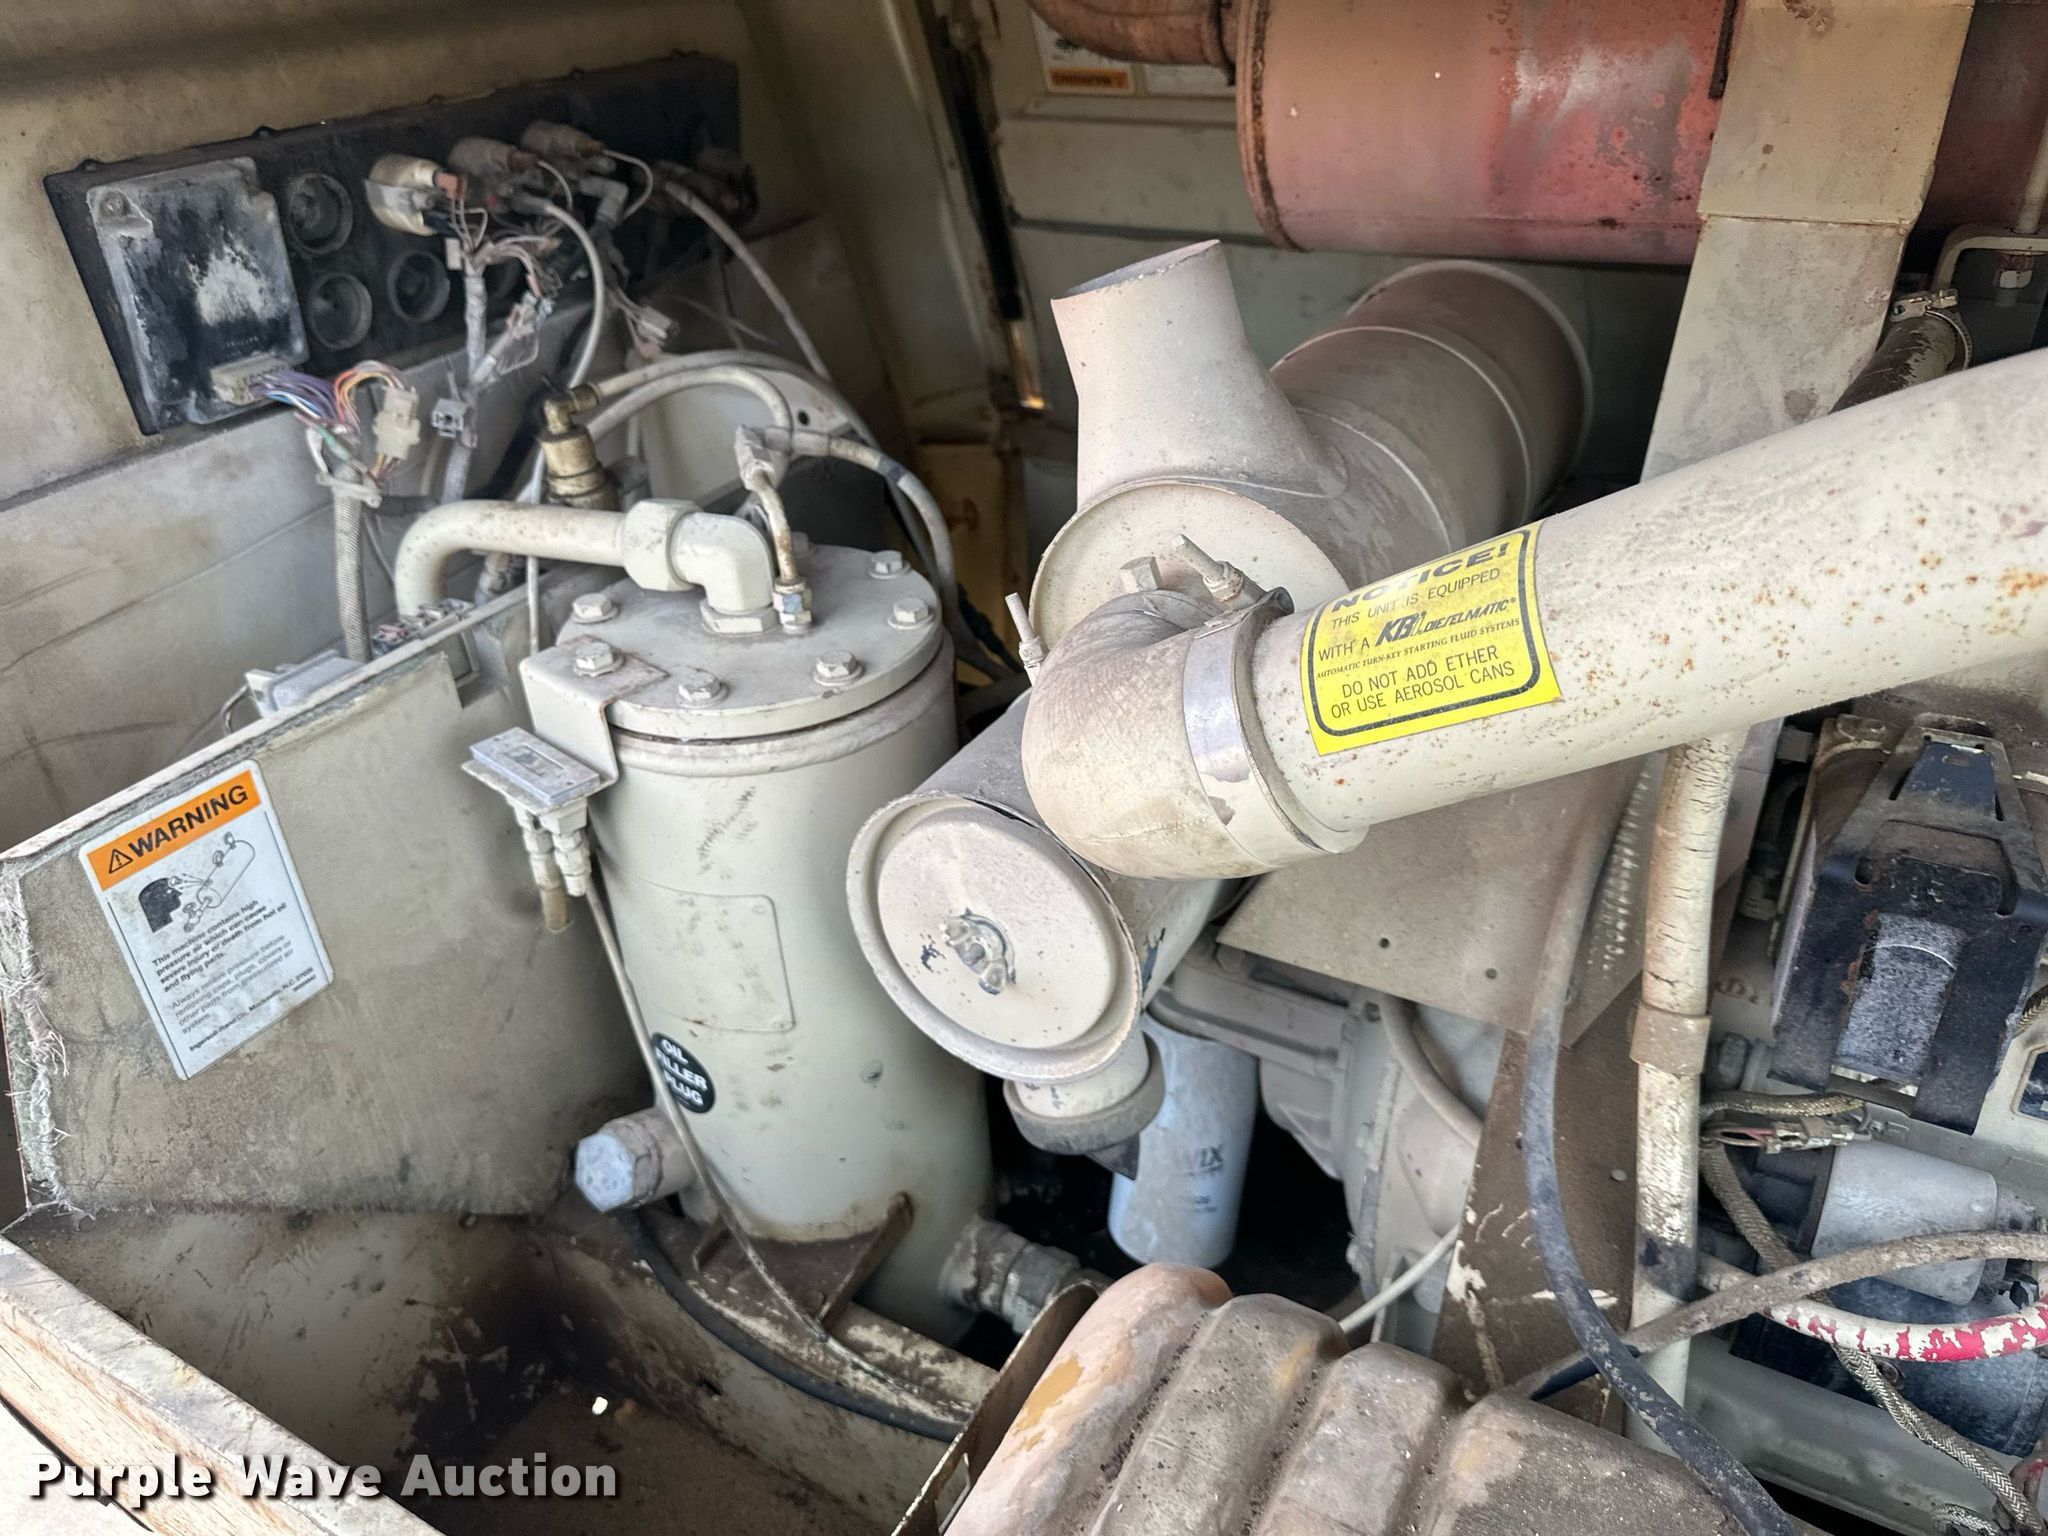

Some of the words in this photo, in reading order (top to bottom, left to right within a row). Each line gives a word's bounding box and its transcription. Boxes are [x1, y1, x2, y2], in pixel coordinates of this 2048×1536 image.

[1332, 612, 1360, 629] THIS
[1368, 603, 1397, 618] UNIT
[1406, 593, 1419, 606] IS
[1428, 567, 1501, 600] EQUIPPED
[1317, 662, 1360, 679] AUTOMATIC
[1363, 651, 1401, 668] TURN-KEY
[1404, 638, 1448, 656] STARTING
[1450, 631, 1477, 643] FLUID
[1480, 618, 1520, 635] SYSTEMS
[1318, 640, 1355, 661] WITH
[1361, 638, 1370, 650] A
[1343, 681, 1363, 698] DO
[1369, 670, 1398, 693] NOT
[1406, 661, 1437, 682] ADD
[1446, 645, 1498, 671] ETHER
[1331, 702, 1351, 719] OR
[1357, 693, 1386, 713] USE
[1395, 675, 1464, 704] AEROSOL
[1470, 661, 1515, 683] CANS
[128, 784, 249, 858] WARNING
[152, 953, 170, 966] This
[172, 932, 206, 955] machine
[207, 912, 240, 937] contains
[241, 900, 259, 914] high
[156, 951, 192, 976] pressure
[194, 943, 202, 953] air
[204, 928, 229, 946] which
[229, 919, 244, 931] can
[245, 906, 267, 924] cause
[160, 966, 186, 984] severe
[187, 951, 210, 970] injury
[212, 942, 222, 952] or
[222, 930, 243, 946] death
[244, 918, 262, 932] from
[263, 910, 276, 920] hot
[277, 902, 287, 913] oil
[164, 980, 180, 992] and
[181, 966, 204, 982] flying
[172, 989, 200, 1009] Always
[227, 951, 259, 975] pressure
[260, 935, 285, 952] before
[176, 993, 212, 1017] removing
[258, 947, 282, 965] covers
[283, 940, 291, 948] or
[179, 1009, 200, 1026] other
[201, 995, 221, 1012] parts
[222, 985, 240, 998] from
[284, 949, 293, 958] air
[655, 1046, 708, 1092] FILLER
[661, 1039, 689, 1065] OIL
[663, 1069, 704, 1107] PLUG
